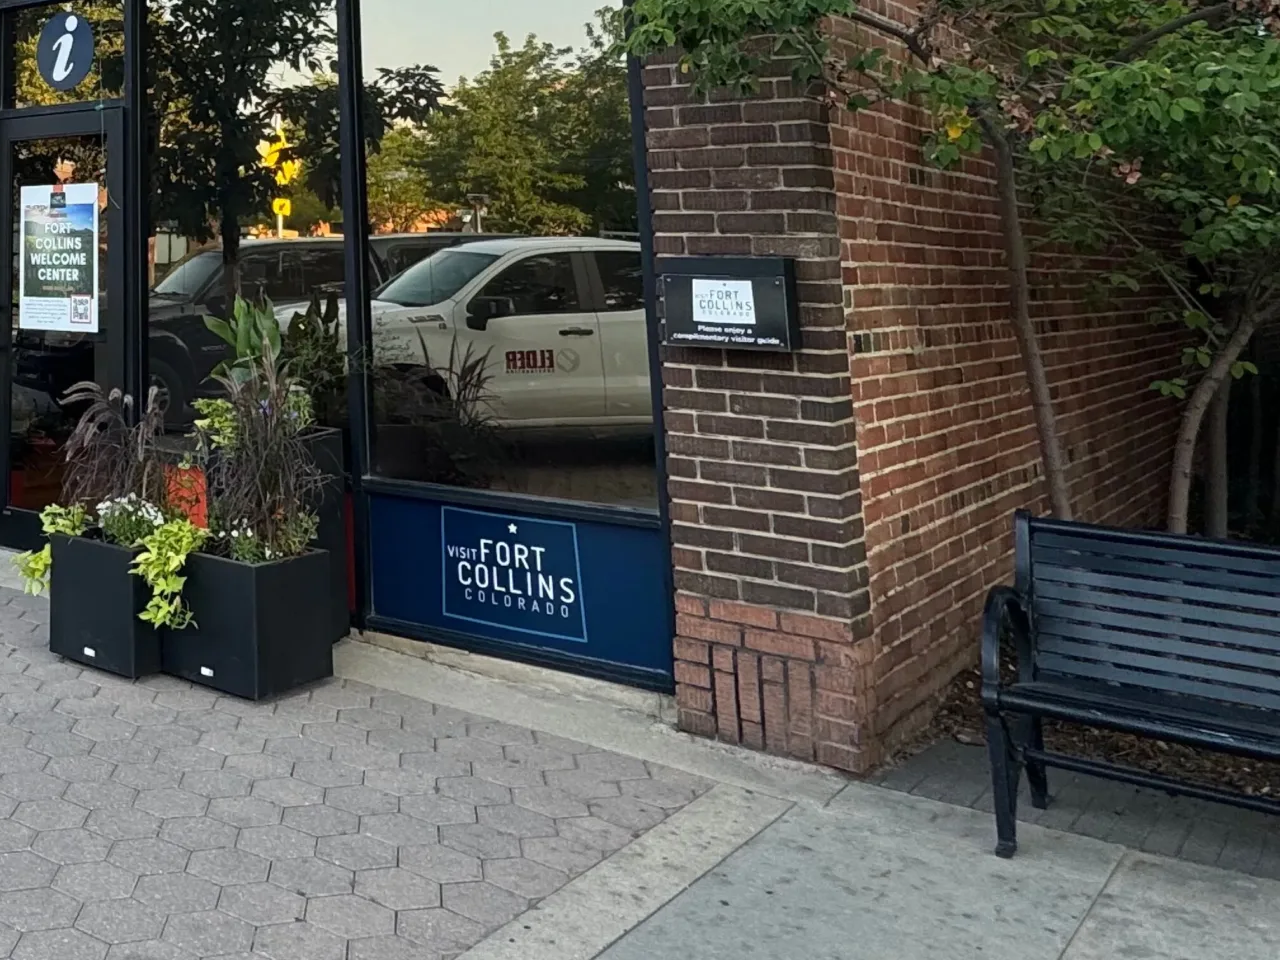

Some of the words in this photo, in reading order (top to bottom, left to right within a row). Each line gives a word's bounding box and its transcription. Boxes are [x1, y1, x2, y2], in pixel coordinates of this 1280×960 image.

[44, 222, 72, 234] FORT
[35, 237, 82, 250] COLLINS
[30, 253, 87, 265] WELCOME
[37, 268, 79, 281] CENTER
[710, 290, 739, 300] FORT
[700, 299, 753, 311] COLLINS
[724, 327, 745, 335] enjoy
[447, 544, 477, 560] VISIT
[480, 538, 545, 571] FORT
[458, 561, 575, 603] COLLINS
[465, 588, 569, 618] COLORADO
